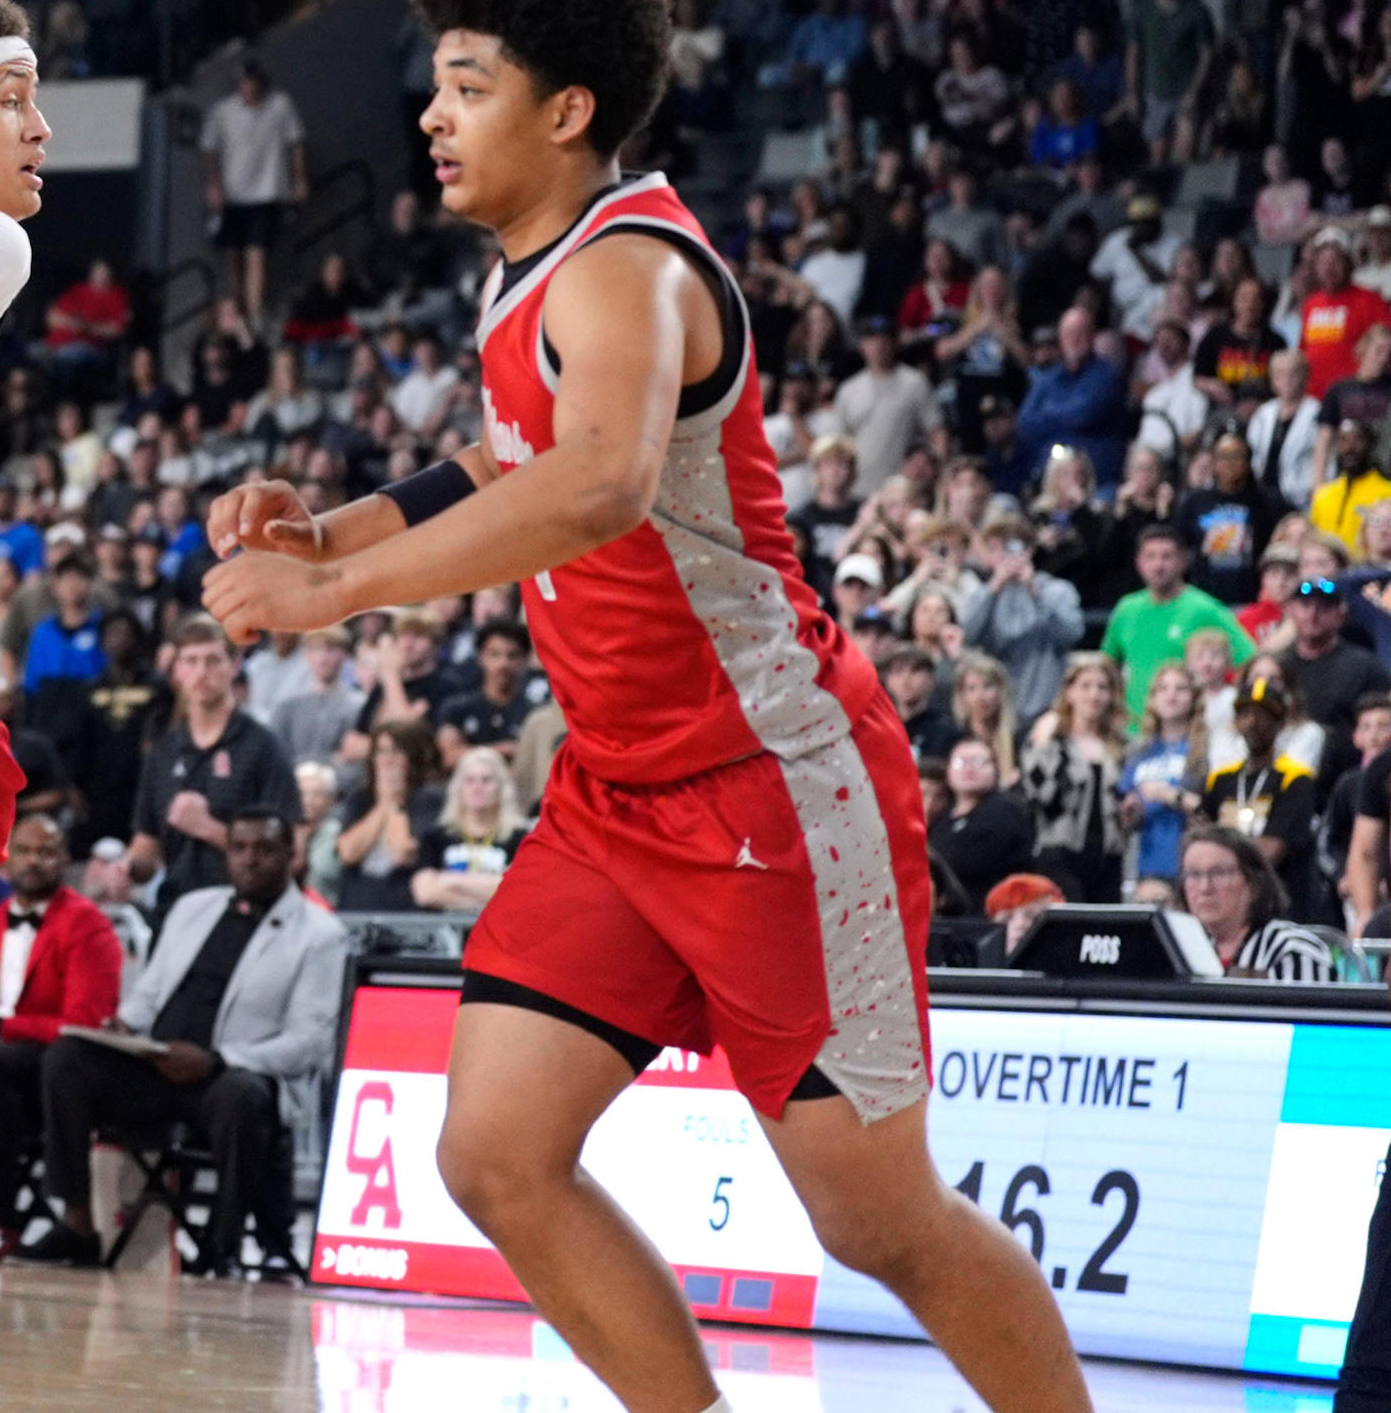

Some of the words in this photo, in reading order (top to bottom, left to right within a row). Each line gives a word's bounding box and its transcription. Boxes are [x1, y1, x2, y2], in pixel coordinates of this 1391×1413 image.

[1079, 934, 1122, 965] POSS
[939, 1050, 1157, 1110] OVERTIME
[1171, 1060, 1191, 1112] 1
[683, 1114, 750, 1145] FOULS
[708, 1176, 734, 1232] 5
